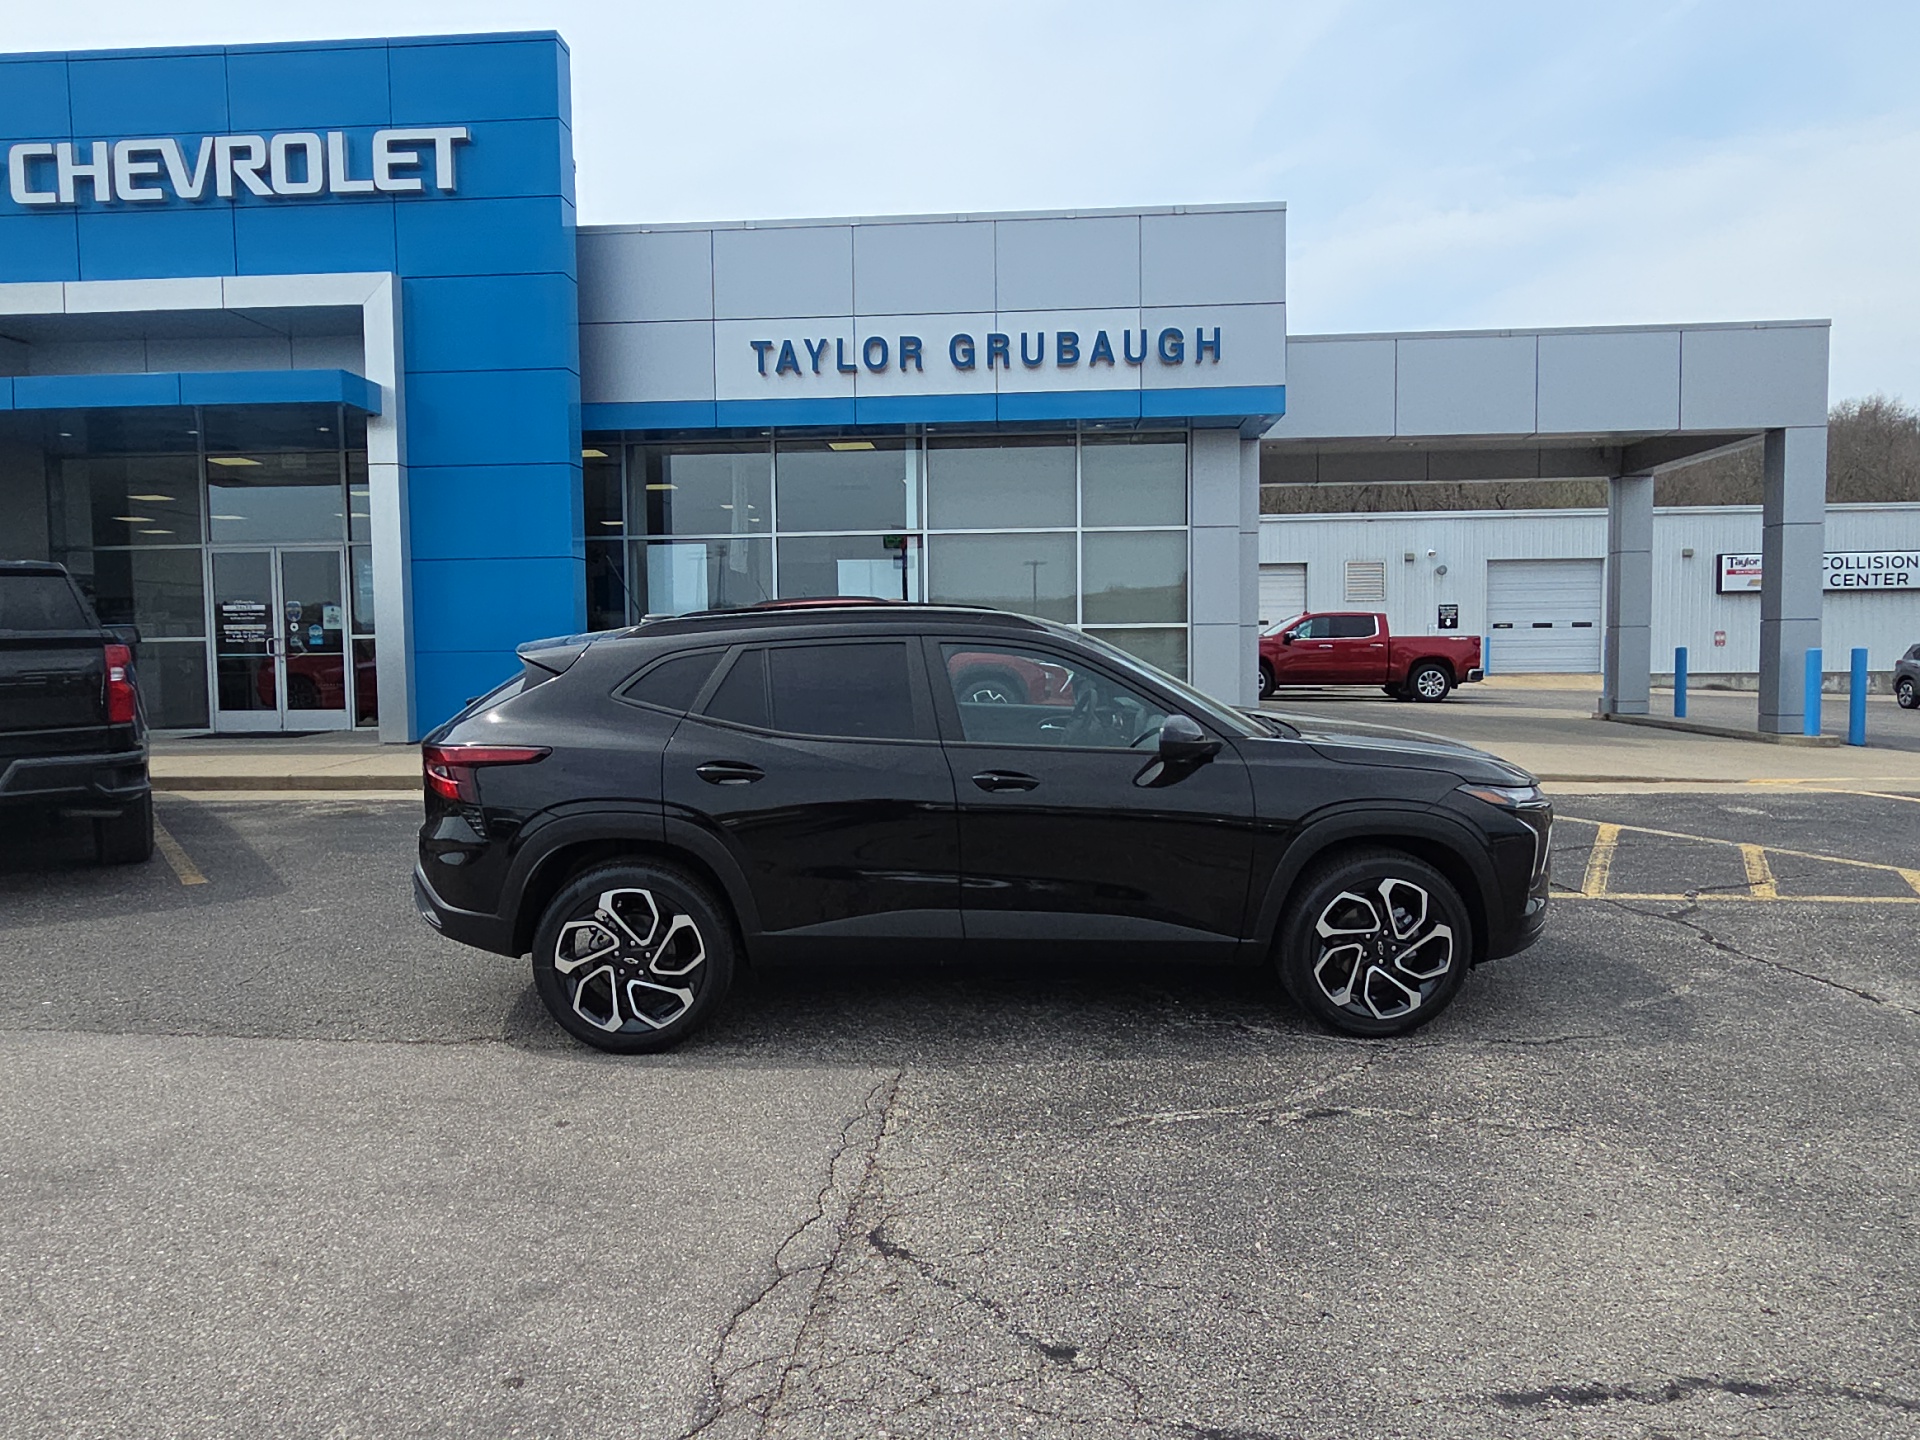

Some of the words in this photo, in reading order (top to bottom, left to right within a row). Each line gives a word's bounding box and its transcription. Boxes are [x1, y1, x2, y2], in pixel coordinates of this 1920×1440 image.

[8, 126, 468, 204] CHEVROLET
[750, 336, 924, 375] TAYLOR
[949, 327, 1222, 370] GRUBAUGH
[1727, 557, 1760, 568] Taylor
[1830, 573, 1909, 586] CENTER
